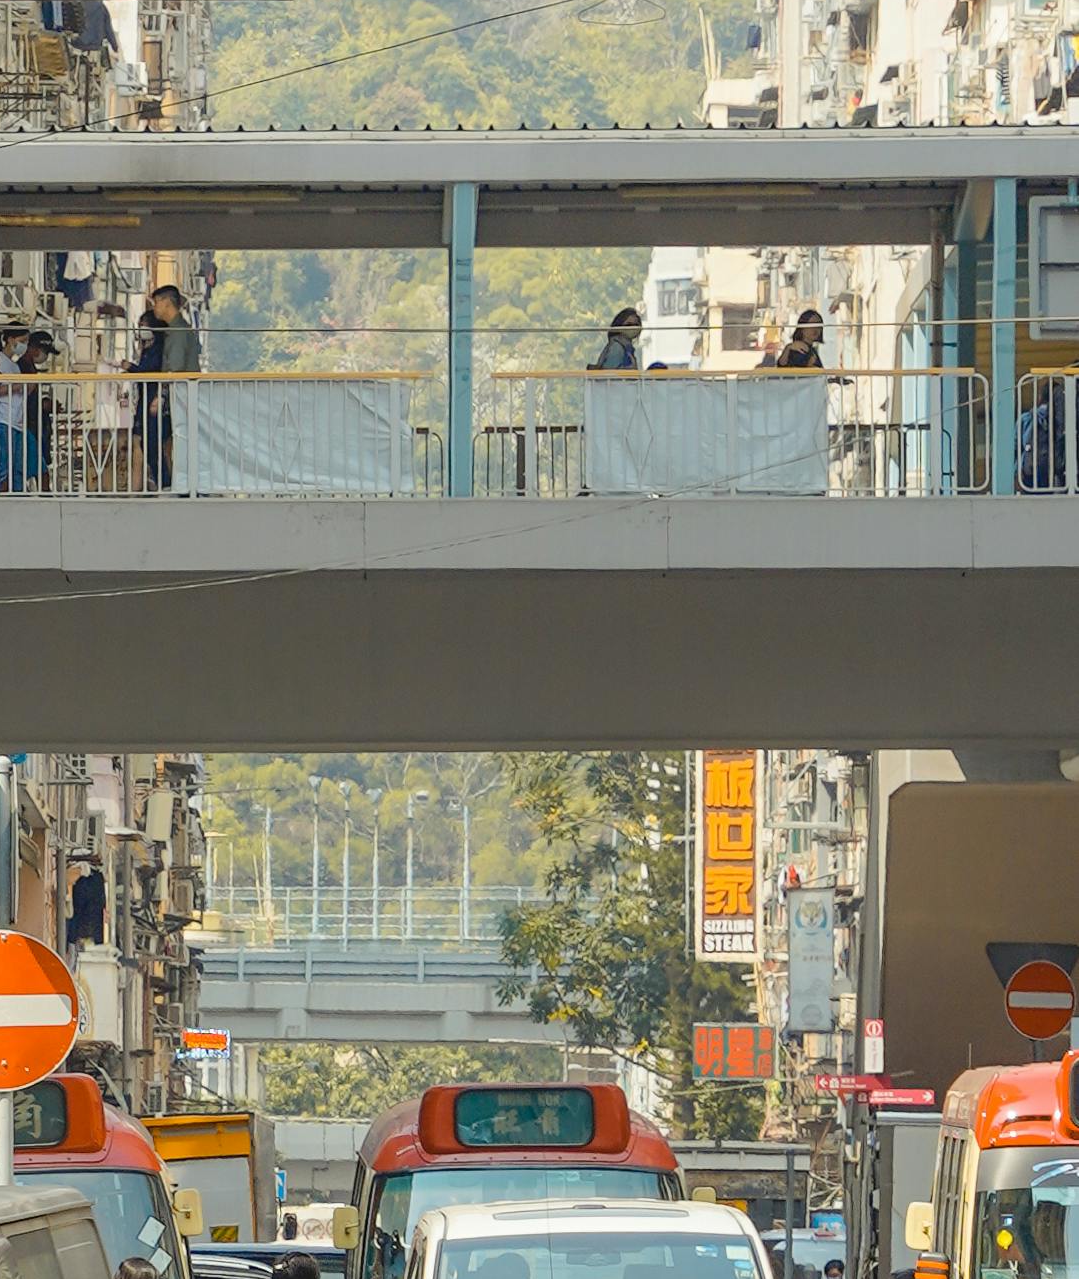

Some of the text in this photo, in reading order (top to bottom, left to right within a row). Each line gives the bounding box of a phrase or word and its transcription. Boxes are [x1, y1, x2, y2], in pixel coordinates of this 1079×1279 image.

[704, 750, 755, 915] 板世家
[704, 932, 755, 953] STEAK
